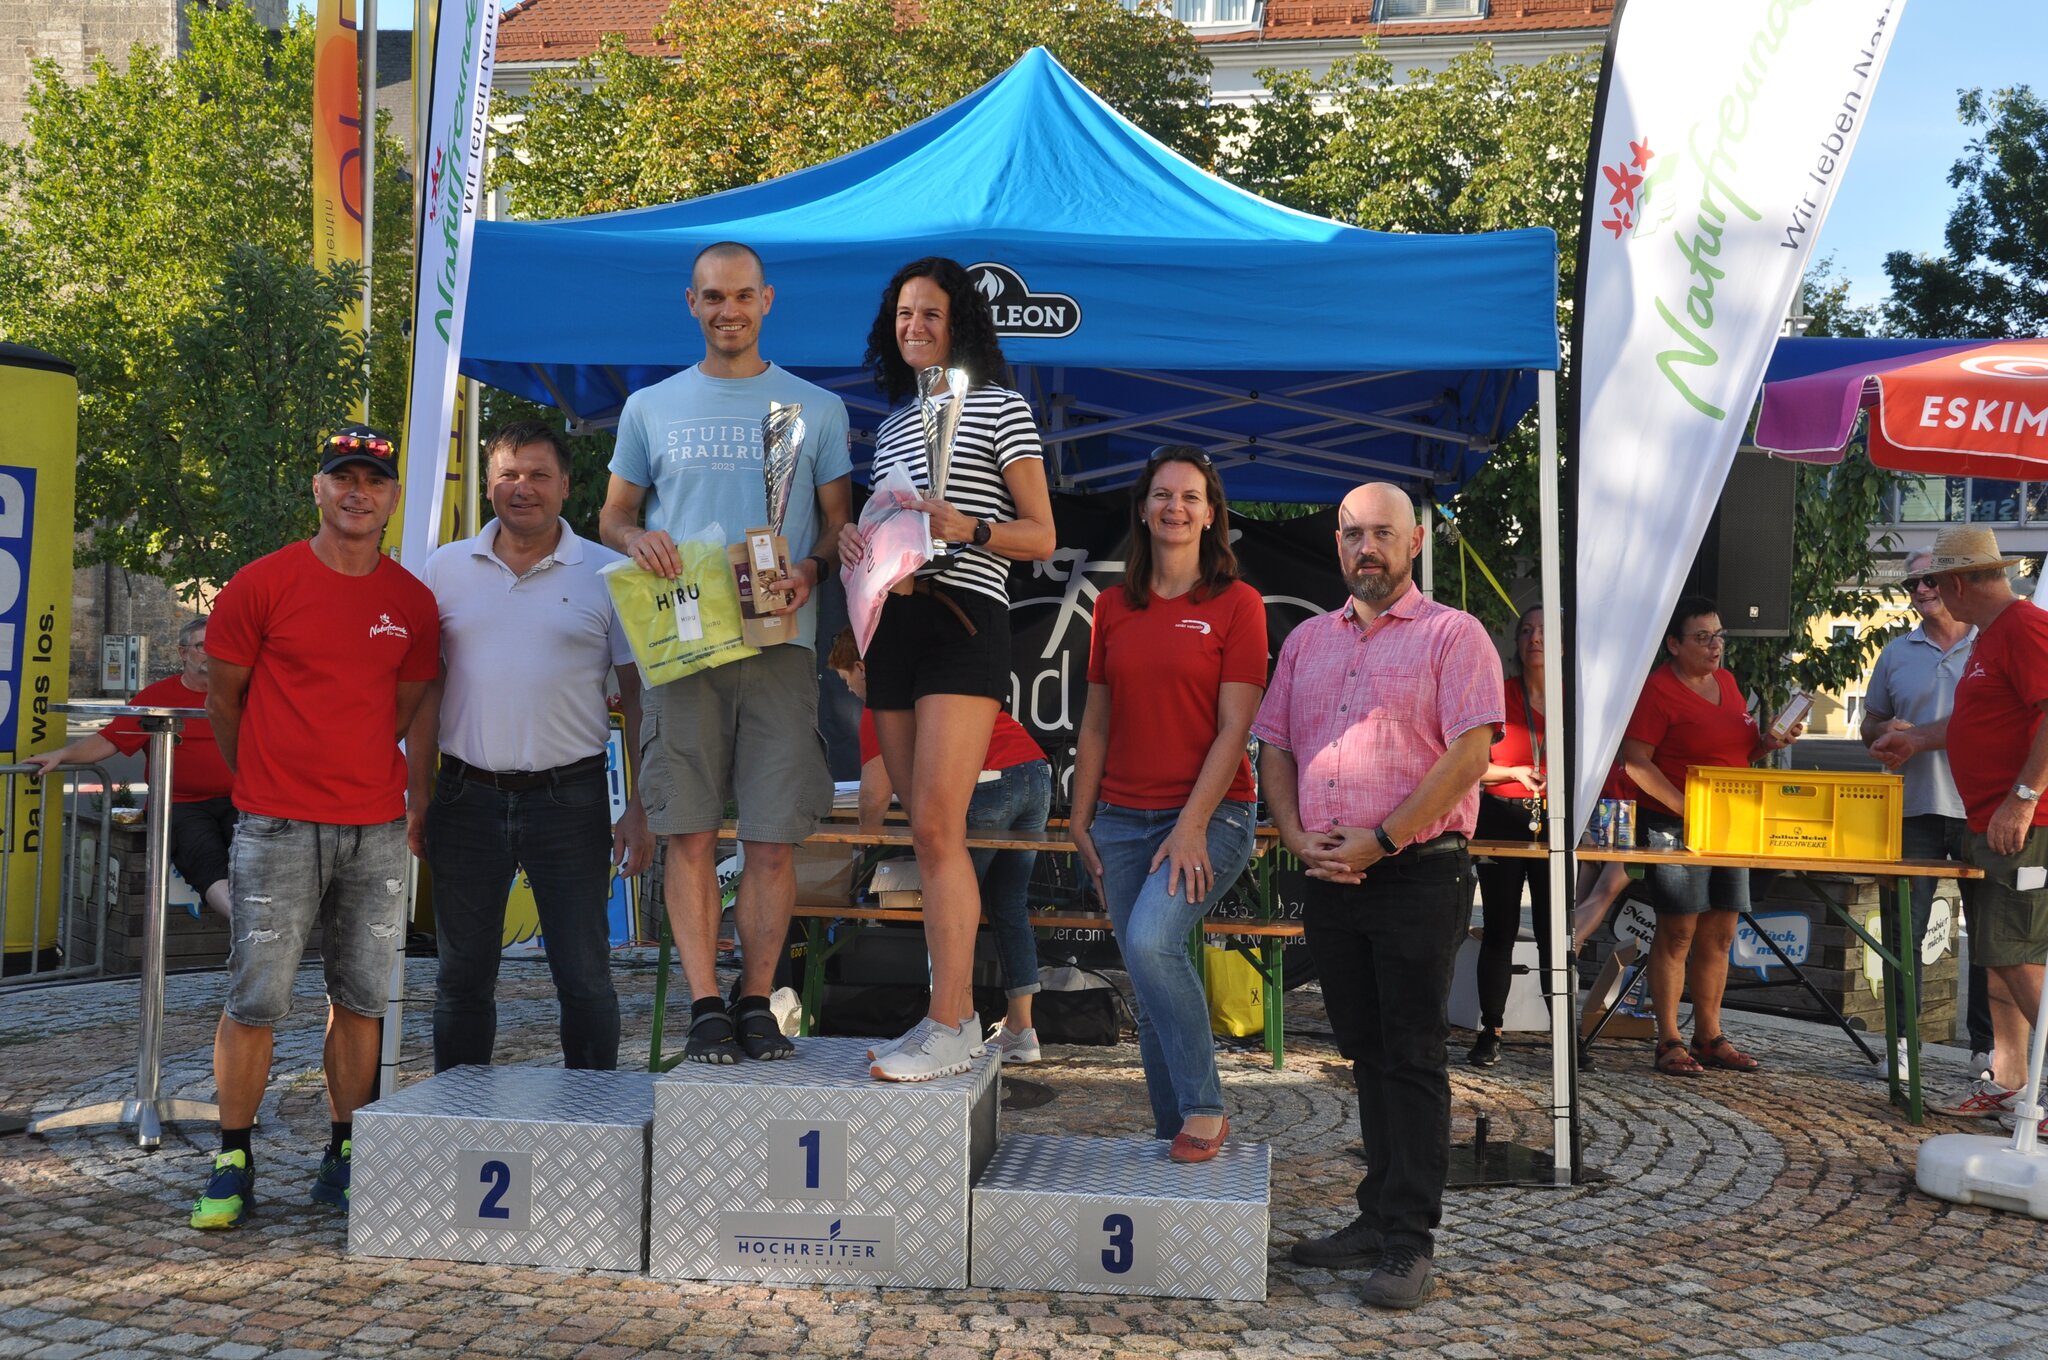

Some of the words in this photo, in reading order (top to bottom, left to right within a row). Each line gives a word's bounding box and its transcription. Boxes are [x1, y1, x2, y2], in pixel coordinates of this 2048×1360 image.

[1781, 192, 1816, 249] Wir
[1809, 91, 1862, 185] leben
[990, 305, 1066, 327] LEON
[711, 462, 735, 471] 2023
[656, 583, 700, 612] HIRU
[32, 604, 55, 663] los.
[31, 674, 50, 744] was
[1769, 840, 1827, 849] FLEISCHWERKE
[799, 1130, 820, 1189] 1
[478, 1161, 511, 1219] 2
[738, 1241, 876, 1258] HOCHREITER
[760, 1257, 854, 1267] METALLBAU
[1101, 1213, 1134, 1274] 3
